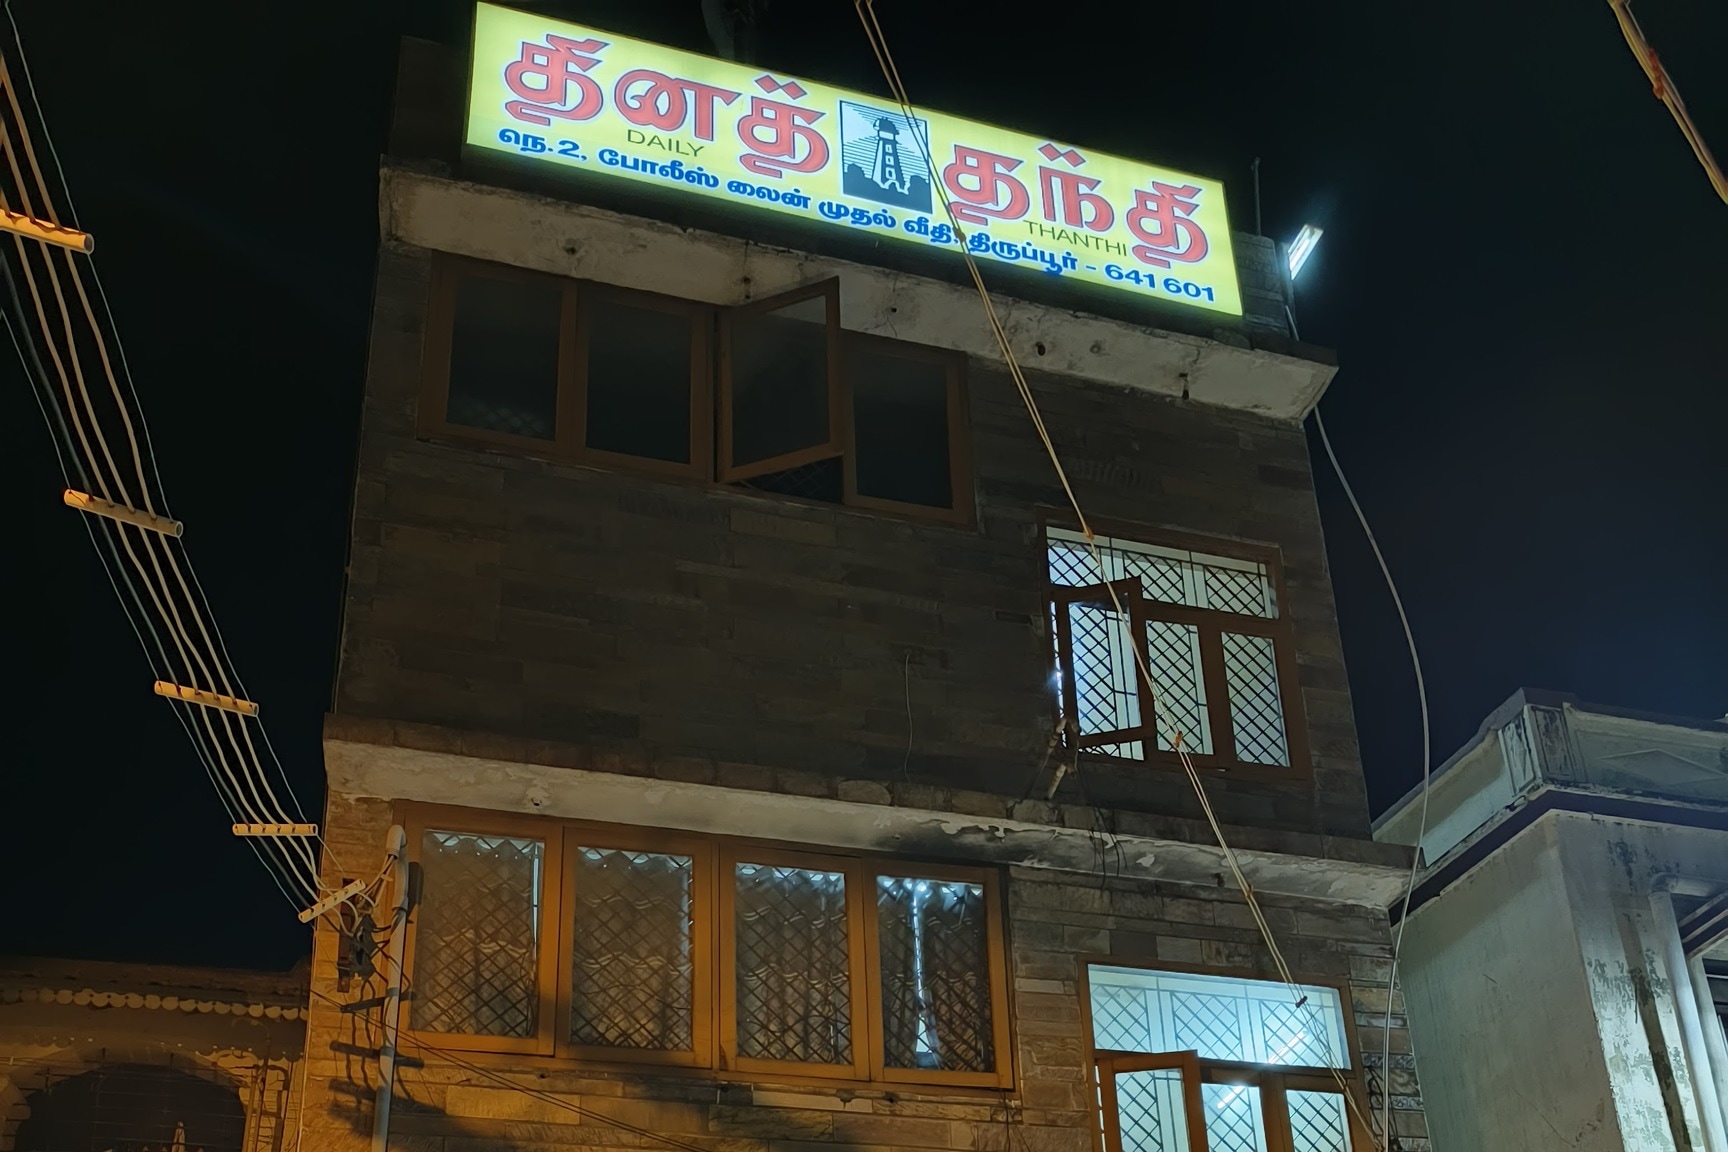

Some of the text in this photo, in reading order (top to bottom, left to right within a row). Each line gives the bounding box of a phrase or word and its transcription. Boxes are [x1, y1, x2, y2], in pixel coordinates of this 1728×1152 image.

[504, 33, 1209, 269] தினத் தந்தி
[598, 149, 720, 189] போலீஸ்
[727, 180, 811, 210] லைன்
[818, 200, 897, 229] முதல்
[969, 231, 1078, 277] திருப்பூர்
[1104, 264, 1156, 289] 641
[1164, 277, 1215, 303] 601
[627, 129, 1128, 257] DAILY THANTHI
